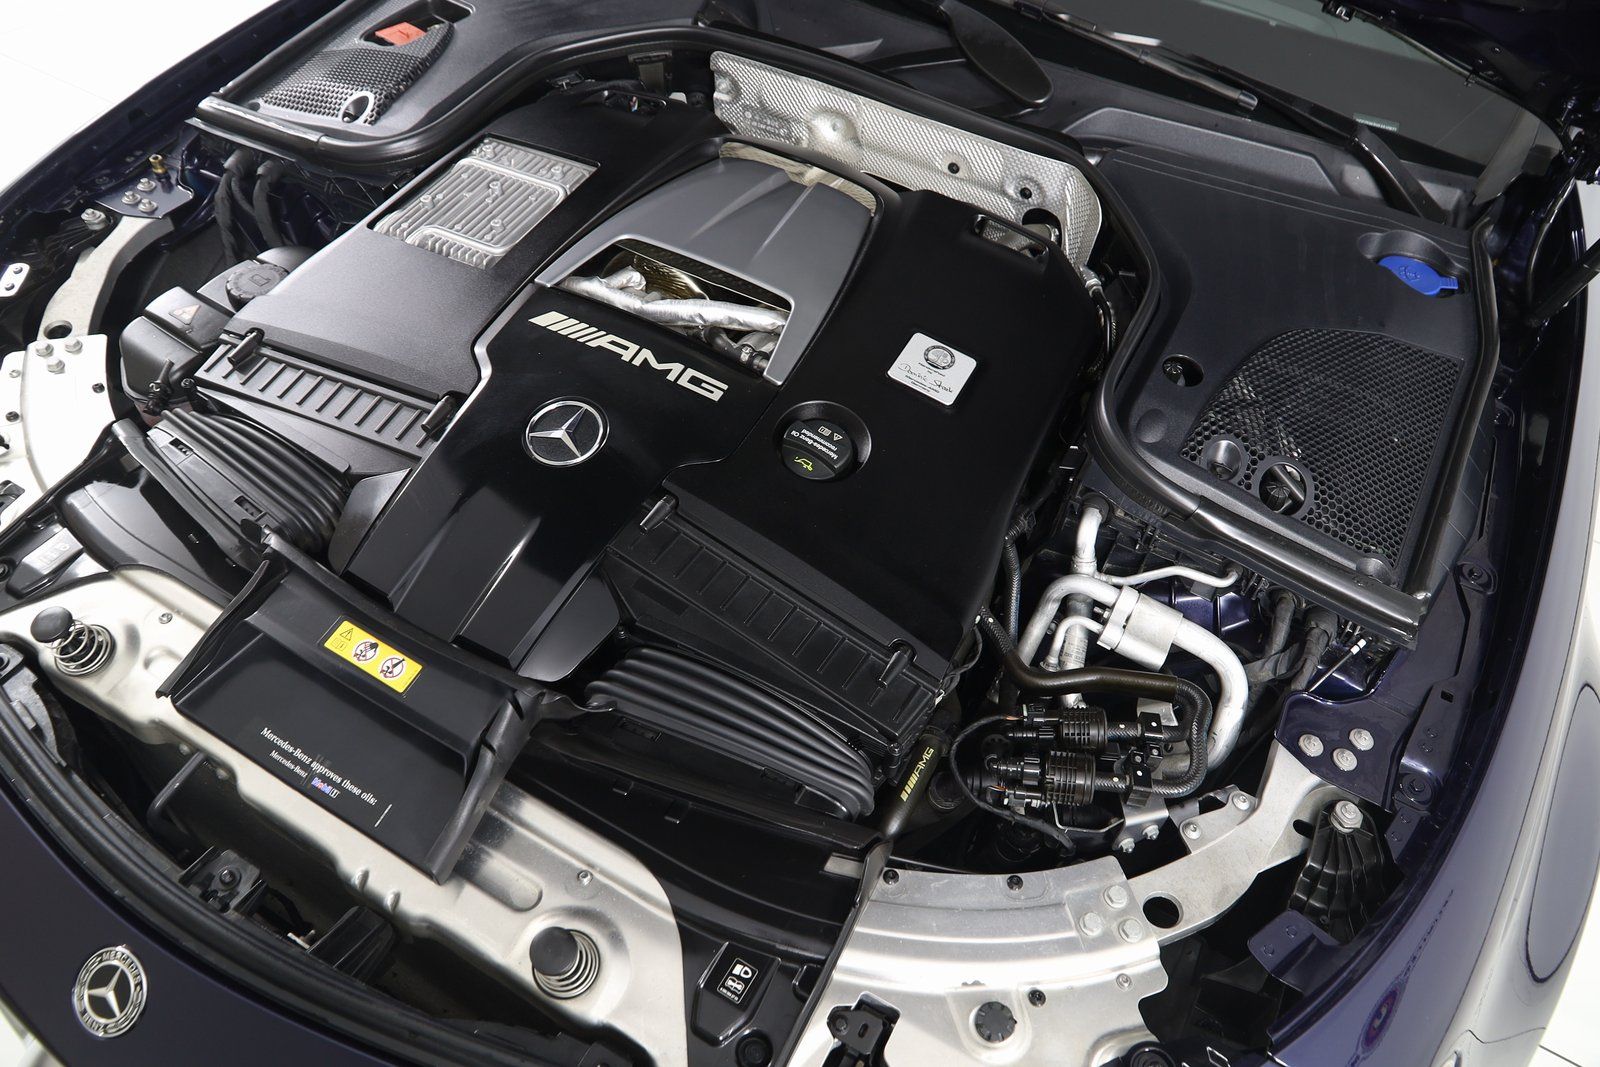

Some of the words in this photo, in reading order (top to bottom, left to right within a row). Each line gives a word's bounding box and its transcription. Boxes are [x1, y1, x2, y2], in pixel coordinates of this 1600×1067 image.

[585, 334, 729, 402] AMG
[799, 434, 839, 460] Mercedes-Benz
[800, 428, 838, 451] recommended
[260, 727, 313, 765] Mercedes-Benz
[310, 761, 343, 784] approves
[341, 778, 362, 796] these
[360, 791, 378, 806] oils:
[269, 749, 309, 779] Mercedes-Benz
